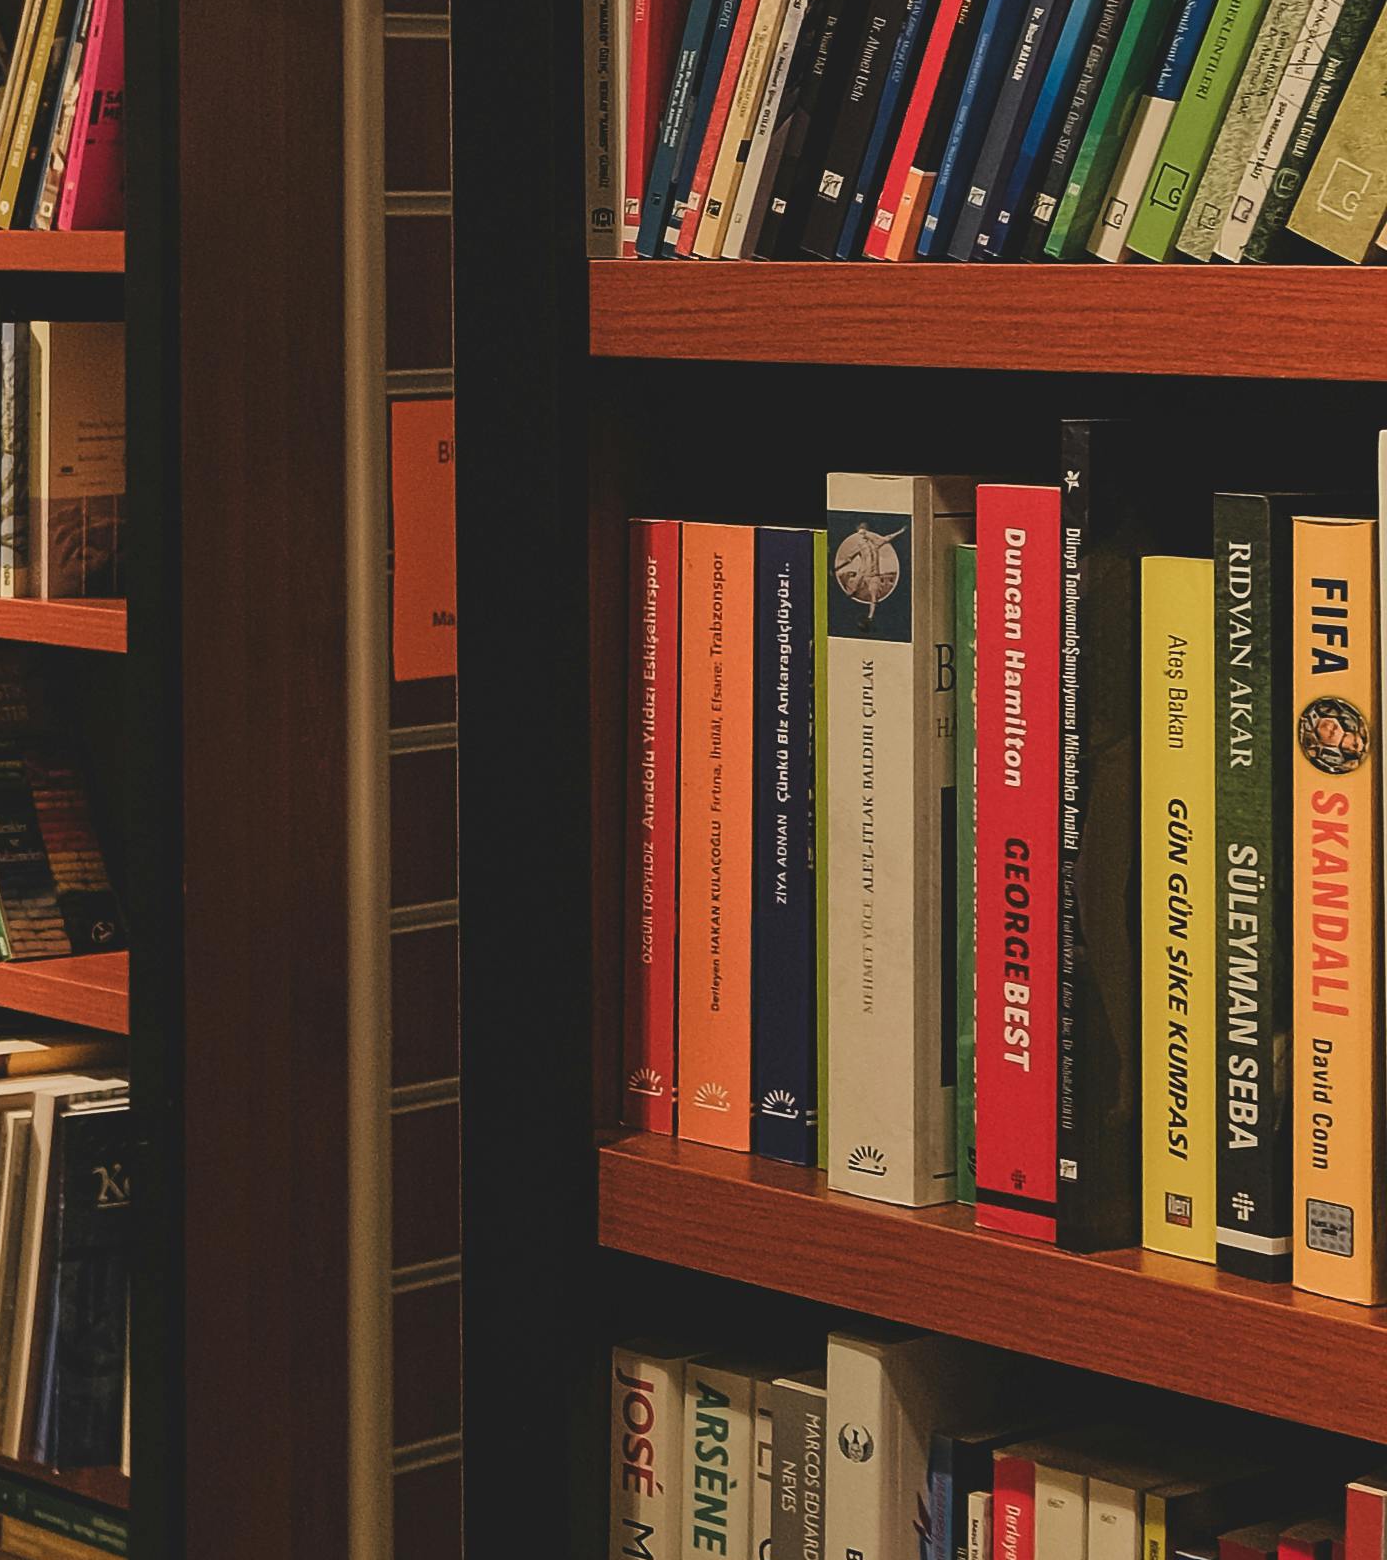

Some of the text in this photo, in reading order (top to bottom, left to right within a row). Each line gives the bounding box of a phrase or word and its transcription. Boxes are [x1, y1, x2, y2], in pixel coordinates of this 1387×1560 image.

[642, 555, 658, 680] Eskişehirspor
[1003, 527, 1027, 641] Duncan
[774, 750, 791, 803] Çünkü
[776, 719, 790, 744] Biz
[1003, 649, 1028, 789] Hamilton
[642, 750, 655, 831] Anadolu
[776, 814, 788, 868] ADNAN
[1226, 541, 1266, 1151] RIDVAN AKAR SÜLEYMAN SEBA
[1310, 577, 1350, 1018] FIFA SKANDALI
[776, 872, 787, 905] ZİYA
[1163, 634, 1193, 1162] Ateş Bakan GÜN GÜN ŞİKE KUMPASI
[1311, 1038, 1334, 1170] David Conn
[616, 1367, 664, 1498] JOSÉ
[693, 1381, 737, 1557] ARSÈNE
[781, 1460, 797, 1513] NEVES
[804, 1413, 821, 1488] MARCOS
